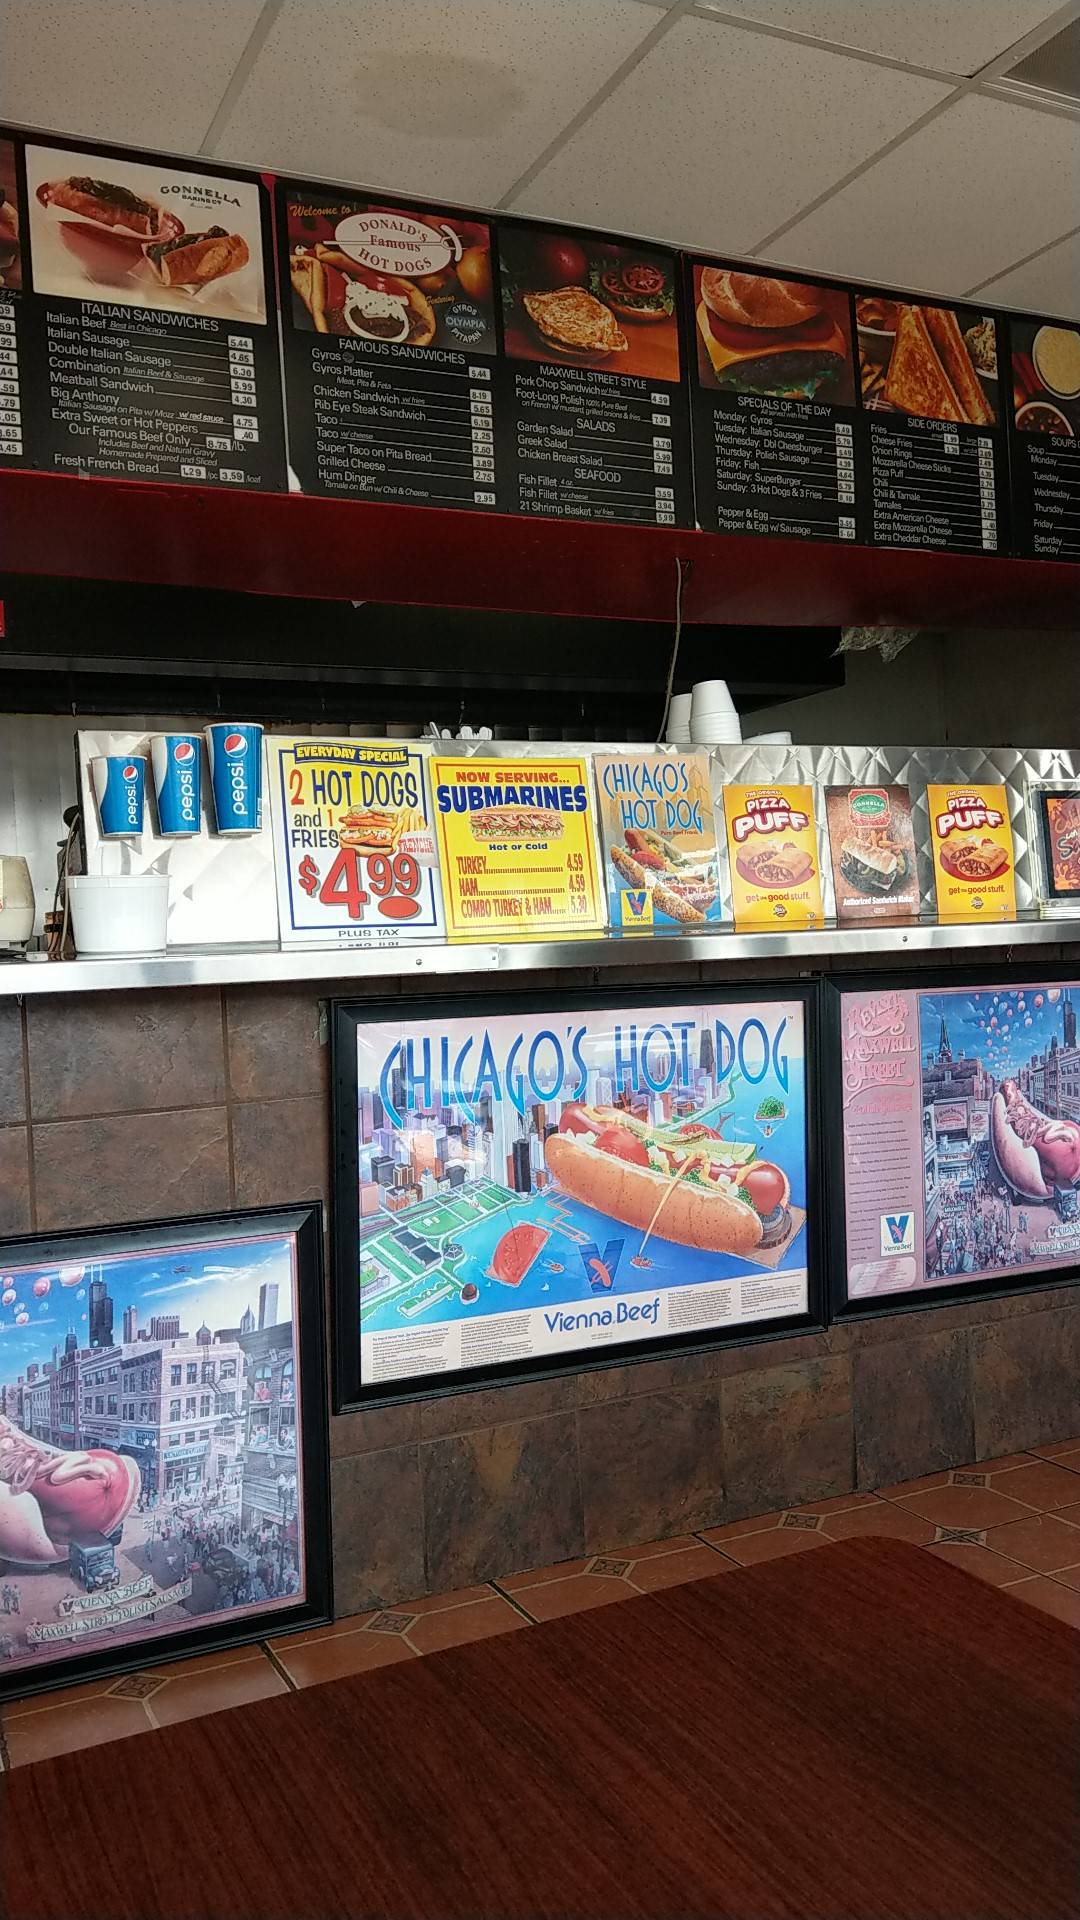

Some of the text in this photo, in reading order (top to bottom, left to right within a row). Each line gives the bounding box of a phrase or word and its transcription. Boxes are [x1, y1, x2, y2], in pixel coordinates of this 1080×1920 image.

[160, 185, 241, 208] GONNELLA
[290, 204, 351, 217] Welcome to
[358, 219, 428, 243] DONALD'S
[370, 234, 421, 252] Famous
[358, 248, 432, 273] HOT DOGS
[81, 302, 219, 332] ITALIAN SANDWICHES
[452, 303, 478, 316] GYROS
[445, 316, 486, 329] OLYMPIA
[47, 327, 130, 348] Italian Sausage
[48, 341, 252, 377] Double Italian Sausage 6.30
[311, 348, 341, 361] Gyros
[339, 338, 466, 365] FAMOUS SANDWICHES
[312, 361, 373, 379] Gyros Platter
[540, 365, 647, 390] MAXWELL STREET STYLE
[515, 374, 601, 396] Pork Chop Sandwich
[50, 386, 120, 405] Big Anthony
[314, 399, 426, 421] Rib Eye Steak Sandwich
[737, 396, 832, 417] SPECIALS OF THE DAY
[52, 408, 198, 434] Extra Sweet or Hot Peppers
[576, 418, 616, 433] SALADS
[870, 424, 887, 434] Fries
[907, 417, 957, 433] SIDE ORDERS
[69, 423, 89, 435] Our
[92, 425, 137, 440] Famous
[140, 430, 164, 441] Beef
[165, 432, 190, 447] Only
[871, 434, 912, 448] Cheese Fries
[1051, 437, 1077, 448] SOUPS
[98, 438, 215, 458] Includes Beef and Natural Gravy
[99, 448, 217, 467] Homemade Prepared and Sliced
[317, 441, 432, 463] Super Taco on Pita Bread
[518, 447, 603, 466] Chicken Breast Salad
[871, 445, 912, 459] Onion Rings
[1027, 444, 1045, 455] Soup
[317, 454, 492, 481] Grilled Cheese 2.75
[1031, 455, 1057, 467] Monday
[318, 469, 376, 485] Hum Dinger
[574, 468, 621, 483] SEAFOOD
[872, 466, 904, 478] Pizza Puff
[1033, 471, 1059, 483] Tuesday
[873, 478, 888, 487] Chili
[519, 487, 558, 500] Fish Fillet
[1033, 488, 1070, 500] Wednesday
[519, 500, 592, 517] 21 Shrimp Basket
[718, 506, 769, 520] Pepper & Egg
[873, 499, 902, 510] Tamales
[1034, 503, 1064, 515] Thursday
[1033, 519, 1053, 530] Friday
[1034, 535, 1062, 547] Saturday
[1034, 544, 1059, 555] Sunday
[296, 746, 407, 762] EVERYDAY SPECIAL
[456, 772, 490, 783] NOW
[603, 762, 688, 800] CHICAGO'S
[177, 770, 195, 821] pepsi
[227, 762, 248, 815] pepsi
[289, 769, 419, 808] 2 HOT DOGS
[125, 784, 139, 825] pepsi
[437, 785, 588, 813] SUBMARINES
[747, 798, 790, 812] PIZZA
[948, 797, 986, 811] PIZZA
[294, 808, 333, 827] and 1
[620, 799, 703, 834] HOT DOG
[734, 812, 807, 840] PUFF
[938, 810, 1001, 836] PUFF
[291, 830, 339, 848] FRIES
[456, 853, 584, 875] TURKEY 4.59
[459, 874, 585, 896] HAM 4.59
[948, 886, 987, 896] get good
[461, 896, 552, 918] COMBO TURKEY & HAM
[745, 893, 759, 903] get
[767, 892, 789, 902] good
[338, 930, 371, 938] PLUS
[614, 1016, 789, 1095] HOT DOG
[378, 1024, 588, 1131] CHICAGO'S
[544, 1312, 612, 1334] Vienna
[616, 1298, 660, 1325] Beef
[77, 1578, 151, 1609] VIENNA BEEF
[33, 1583, 190, 1640] MAXWELL STREET POLISH SAUSAGE
